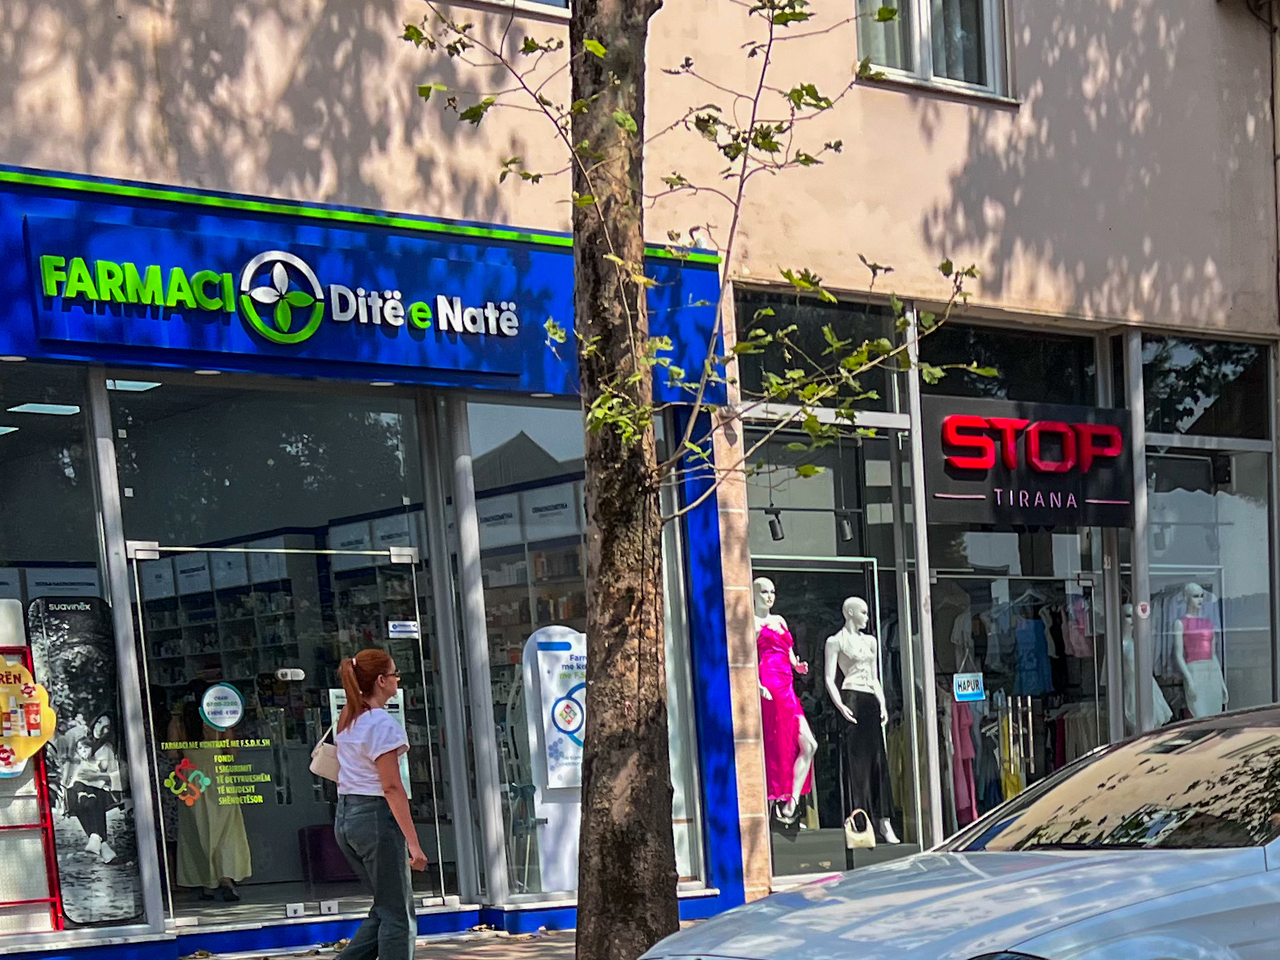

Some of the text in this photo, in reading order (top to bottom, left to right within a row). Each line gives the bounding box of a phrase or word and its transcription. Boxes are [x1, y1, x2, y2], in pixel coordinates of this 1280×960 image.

[40, 255, 519, 337] FARMACI Ditë e Natë
[942, 414, 1124, 474] STOP
[993, 488, 1078, 509] TIRANA
[957, 679, 981, 692] HAPUR
